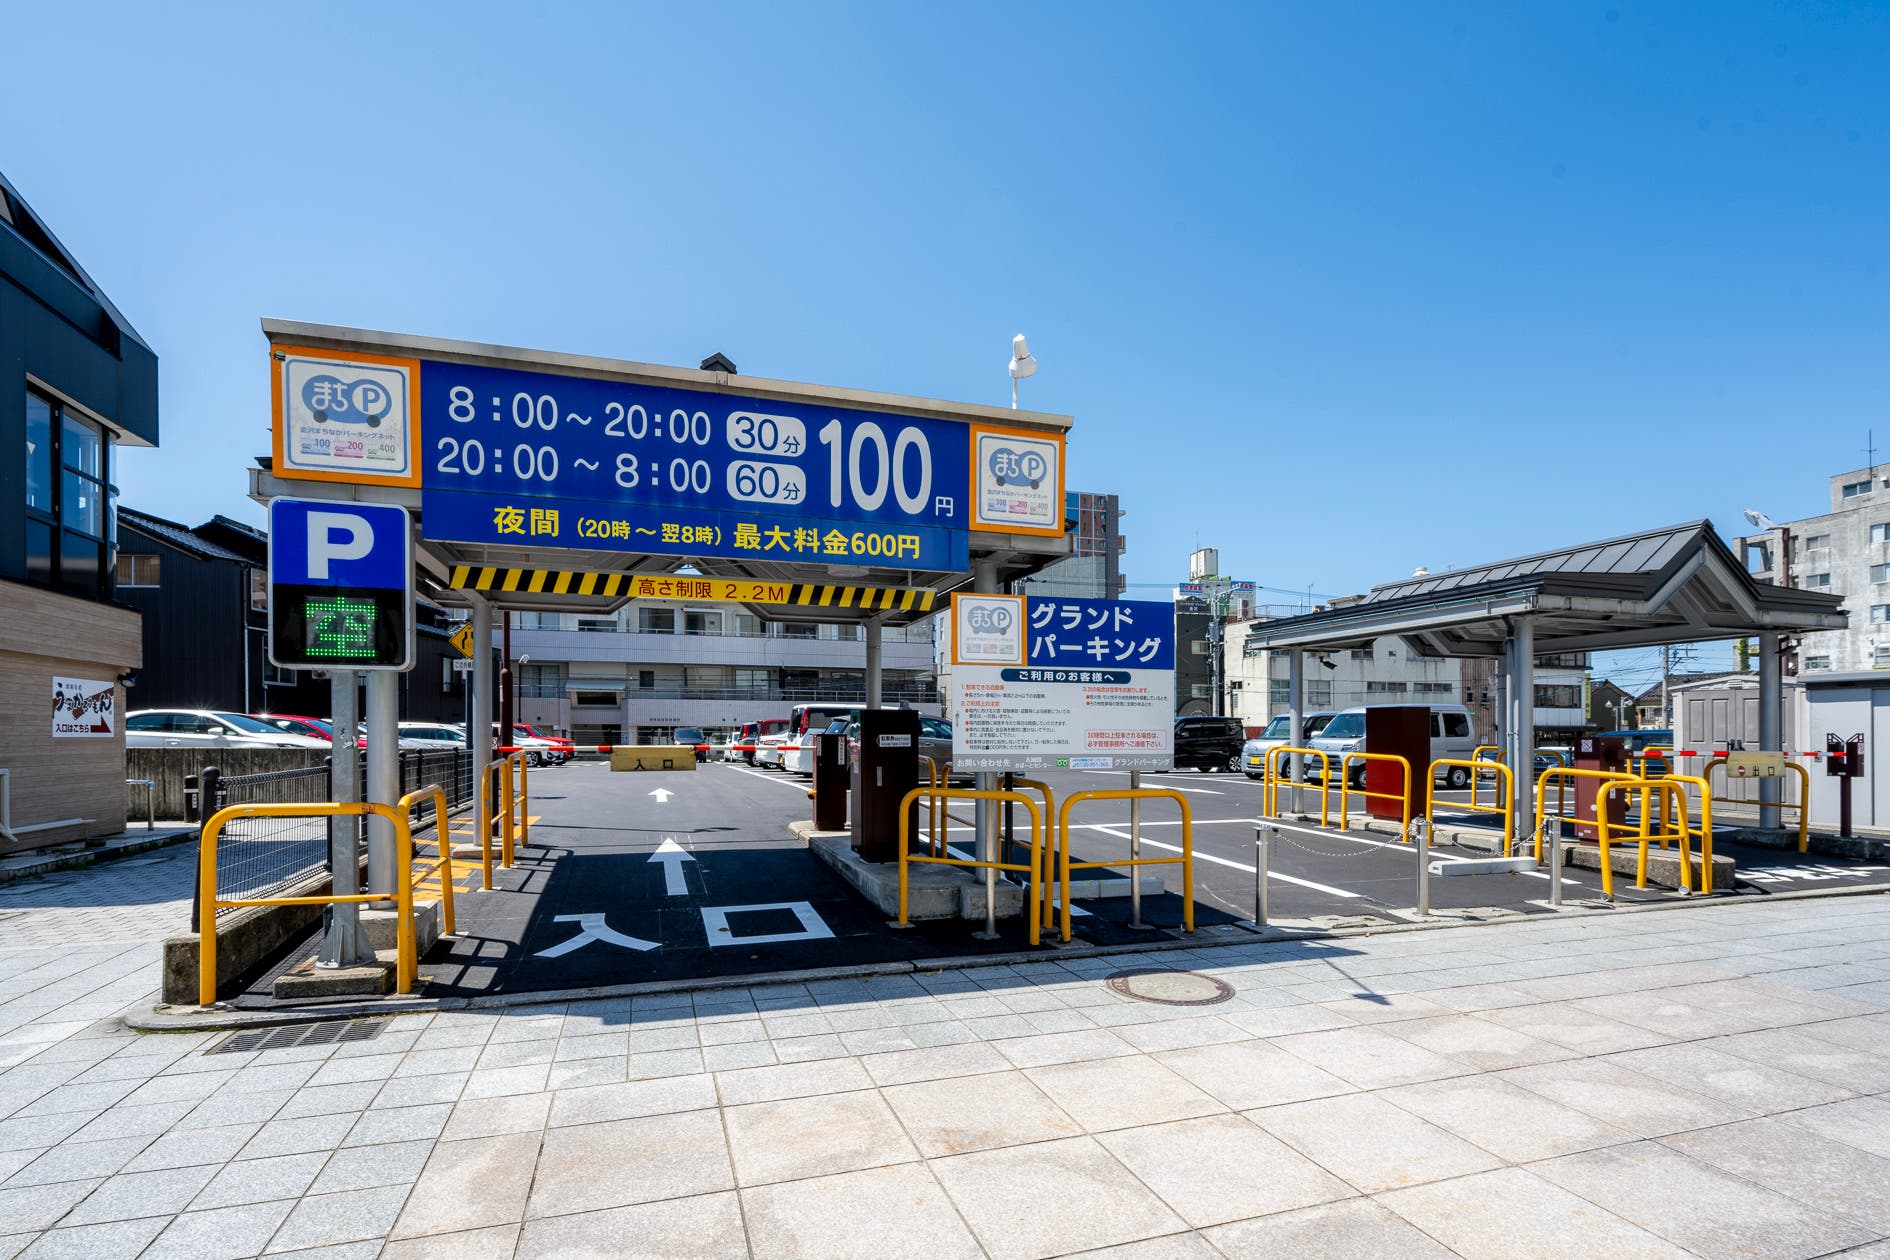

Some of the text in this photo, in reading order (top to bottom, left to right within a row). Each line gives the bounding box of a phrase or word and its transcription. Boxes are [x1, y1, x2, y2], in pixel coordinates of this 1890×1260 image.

[734, 416, 800, 454] 30分
[735, 464, 800, 501] 60分
[307, 510, 375, 580] P
[493, 506, 560, 538] 夜間
[733, 523, 920, 560] 最大料金600円
[638, 578, 784, 602] 高さ制限 2.2M
[306, 596, 376, 657] 空
[1031, 603, 1134, 632] グランド
[1031, 633, 1161, 663] パーキング
[1019, 670, 1114, 682] ご利用のお客様へ
[56, 724, 90, 733] 入口はこちら
[634, 759, 674, 769] 入口
[957, 758, 1012, 768] お問い合わせ先
[1114, 758, 1171, 767] グランドパーキング
[1753, 764, 1775, 776] 出口
[533, 901, 836, 958] 入口
